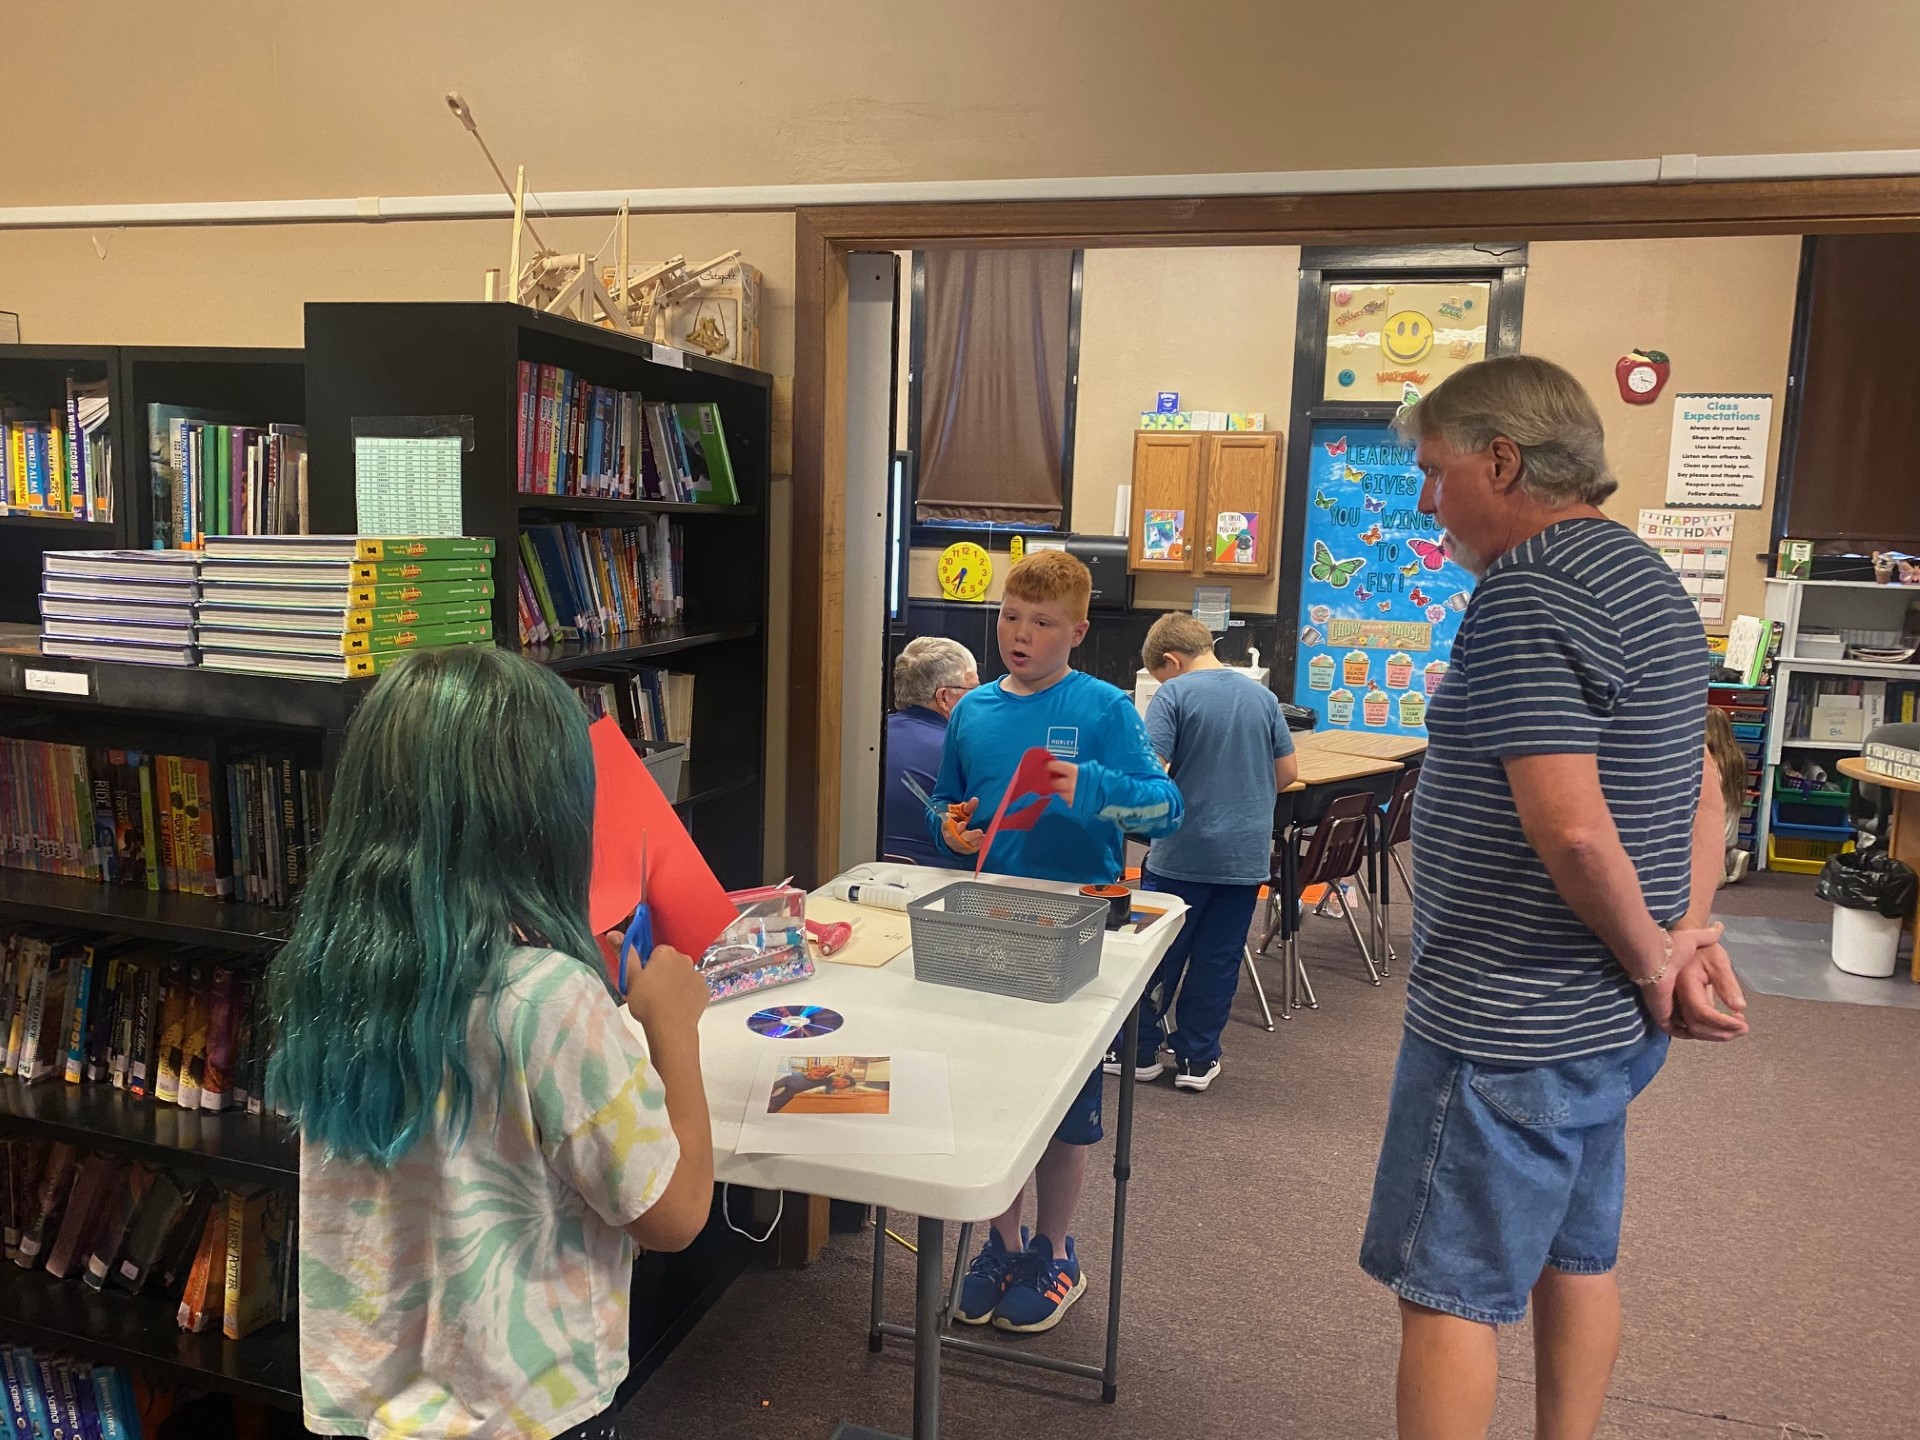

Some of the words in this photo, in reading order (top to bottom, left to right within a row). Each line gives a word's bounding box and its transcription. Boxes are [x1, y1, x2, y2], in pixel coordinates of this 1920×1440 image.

[700, 267, 738, 284] Catapult
[1684, 411, 1760, 422] Expectations
[1707, 402, 1738, 411] Class
[67, 414, 76, 440] WORLD
[17, 434, 25, 462] WORLD
[28, 439, 36, 468] WORLD
[69, 442, 78, 474] RECORDS
[1346, 444, 1416, 466] LEARNI
[18, 464, 26, 502] ALMANAC
[1362, 473, 1417, 496] GIVES
[1329, 507, 1361, 527] YOU
[1662, 515, 1711, 526] HAPPY
[1648, 524, 1723, 537] BIRTHDAY
[1377, 542, 1399, 562] TO
[942, 566, 948, 574] 9
[945, 576, 951, 584] 8
[396, 609, 419, 623] Wonders
[393, 632, 417, 645] Wonders
[1331, 621, 1361, 640] GROW
[1385, 623, 1428, 644] MINDSET
[94, 780, 107, 807] RIDE
[283, 800, 295, 829] GONE
[162, 832, 173, 868] FUNNY
[286, 843, 298, 885] WOODS
[229, 1218, 240, 1253] HARRY
[228, 1254, 239, 1290] POTTER
[9, 1385, 22, 1413] Science
[25, 1387, 36, 1413] Science
[46, 1395, 59, 1424] Science
[67, 1402, 78, 1429] Science
[104, 1410, 116, 1436] Science
